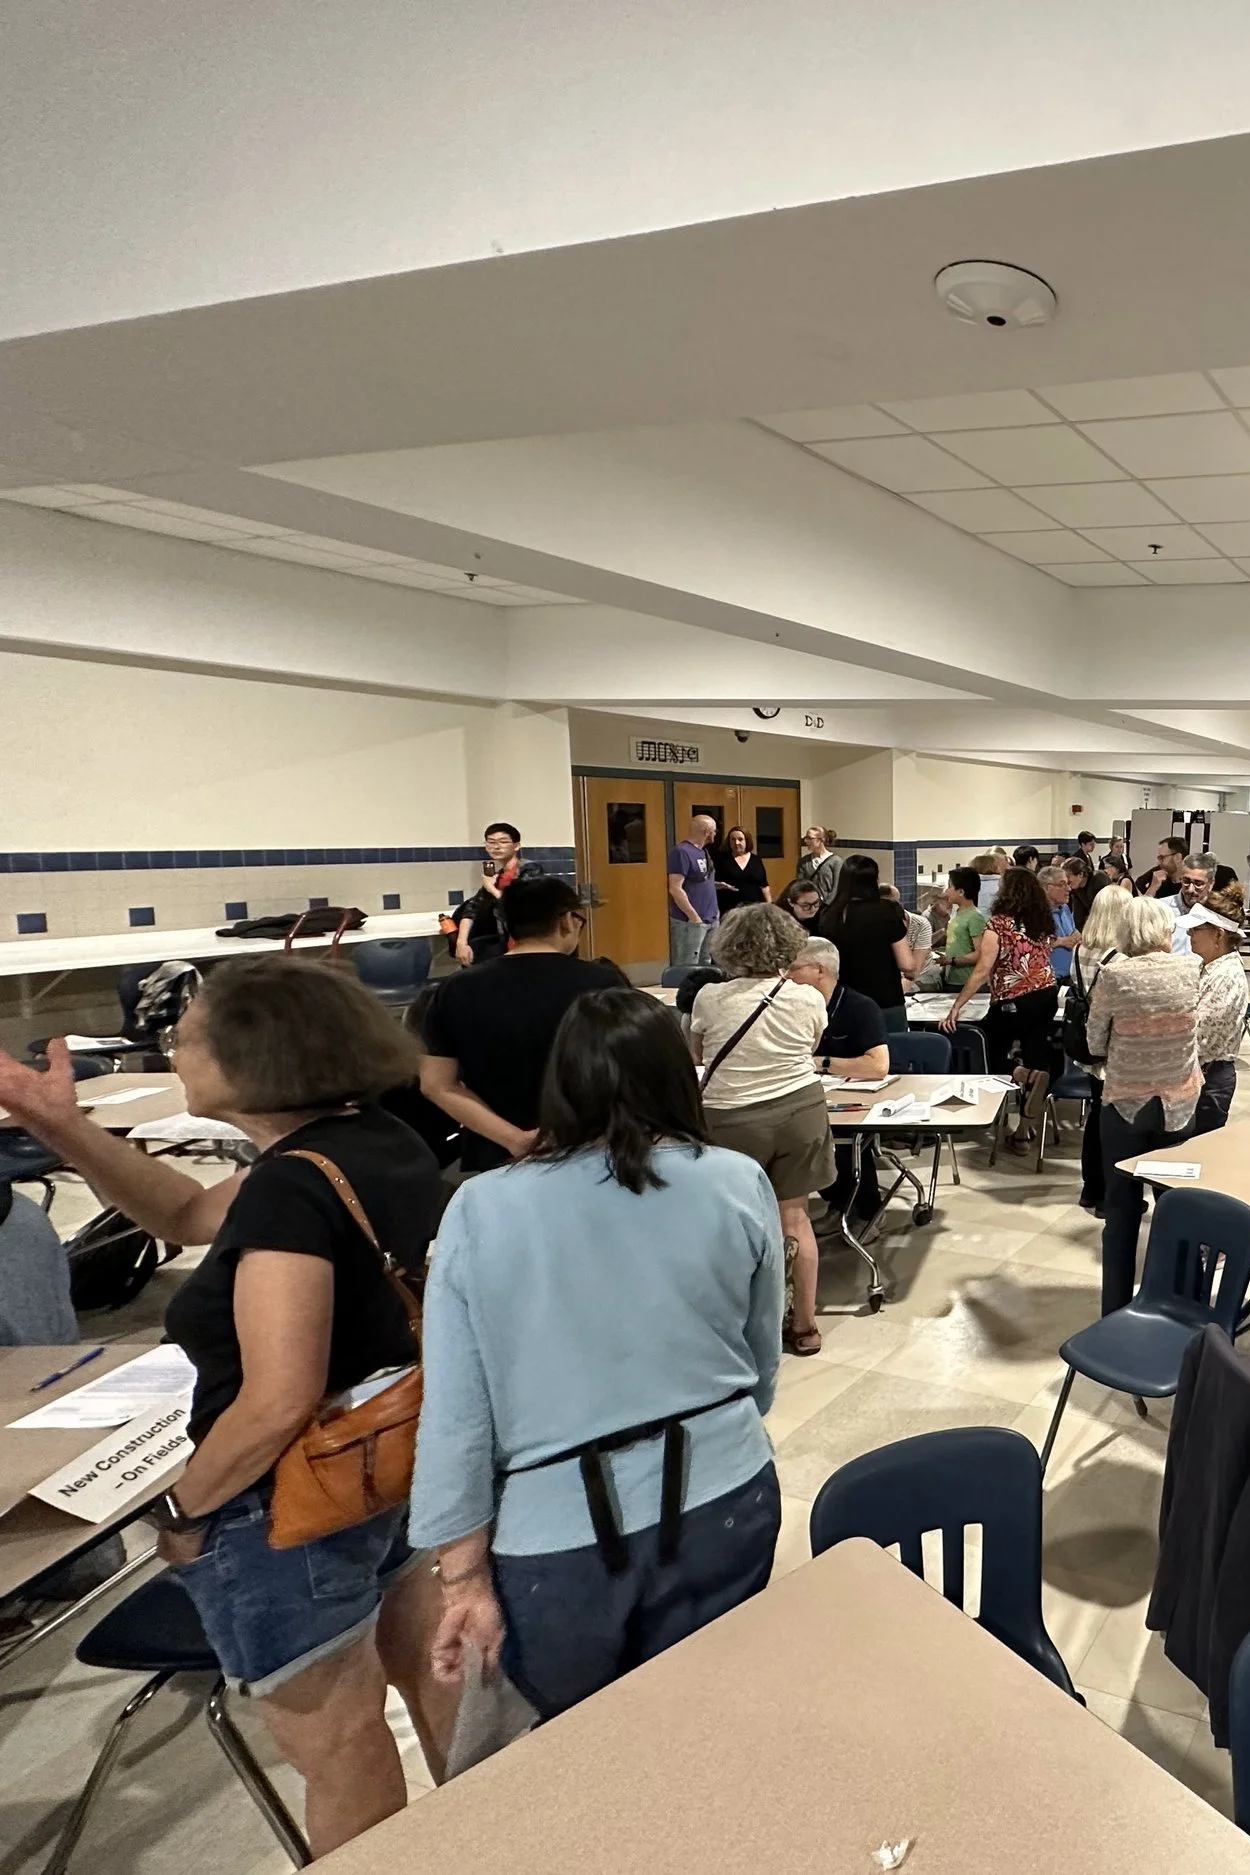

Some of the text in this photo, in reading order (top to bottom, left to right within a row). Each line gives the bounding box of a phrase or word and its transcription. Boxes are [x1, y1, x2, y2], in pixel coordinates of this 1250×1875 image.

[58, 1408, 186, 1497] New Construction
[121, 1465, 148, 1482] On
[142, 1435, 187, 1466] Fields
